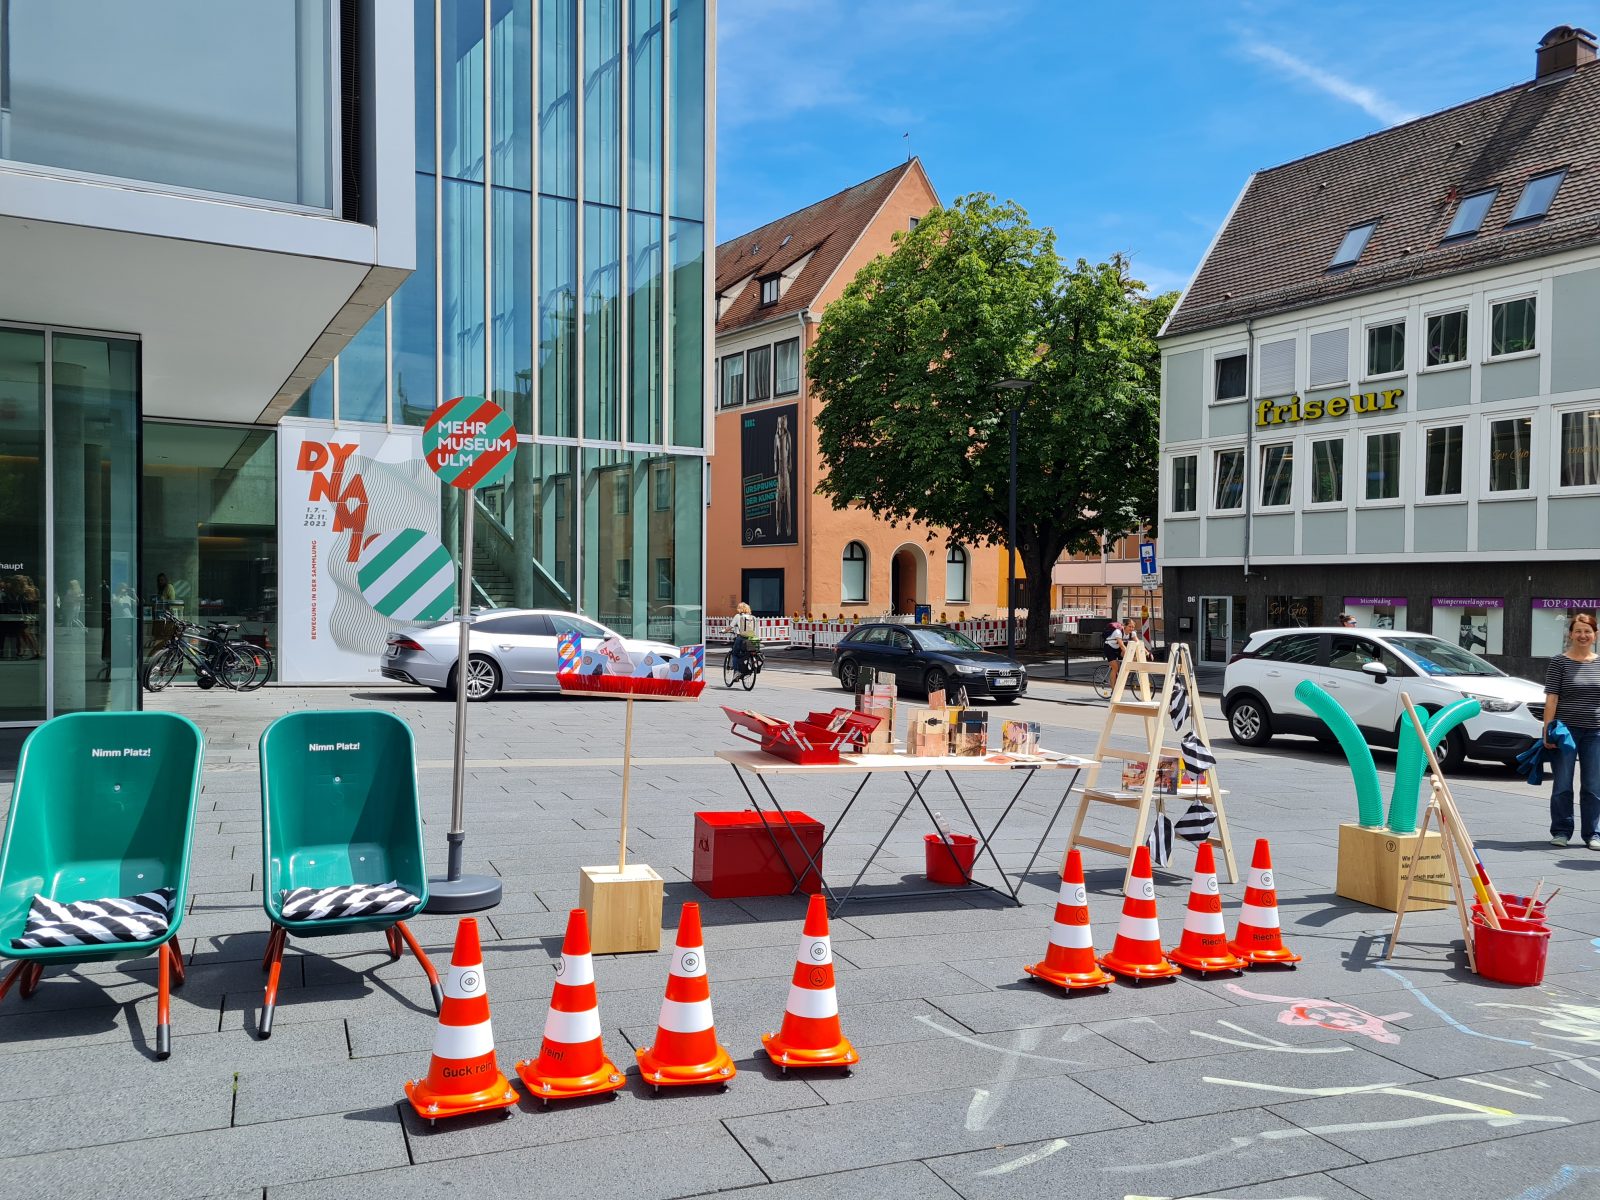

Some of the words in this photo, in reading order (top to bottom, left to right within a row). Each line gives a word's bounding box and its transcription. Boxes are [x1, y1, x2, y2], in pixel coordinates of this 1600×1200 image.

[1255, 388, 1404, 426] friseur
[437, 420, 487, 435] MEHR
[437, 437, 511, 452] MUSEUM
[437, 453, 473, 467] ULM
[745, 479, 778, 494] URSPRUNG
[758, 492, 778, 502] KUNST
[311, 593, 317, 601] IN
[1542, 599, 1560, 608] TOP
[91, 748, 122, 757] Nimm
[123, 748, 151, 757] Platz!
[309, 743, 335, 751] Nimm
[336, 742, 360, 750] Platz!
[1253, 933, 1274, 941] Riech
[544, 1047, 564, 1061] rein!
[442, 1065, 473, 1078] Guck
